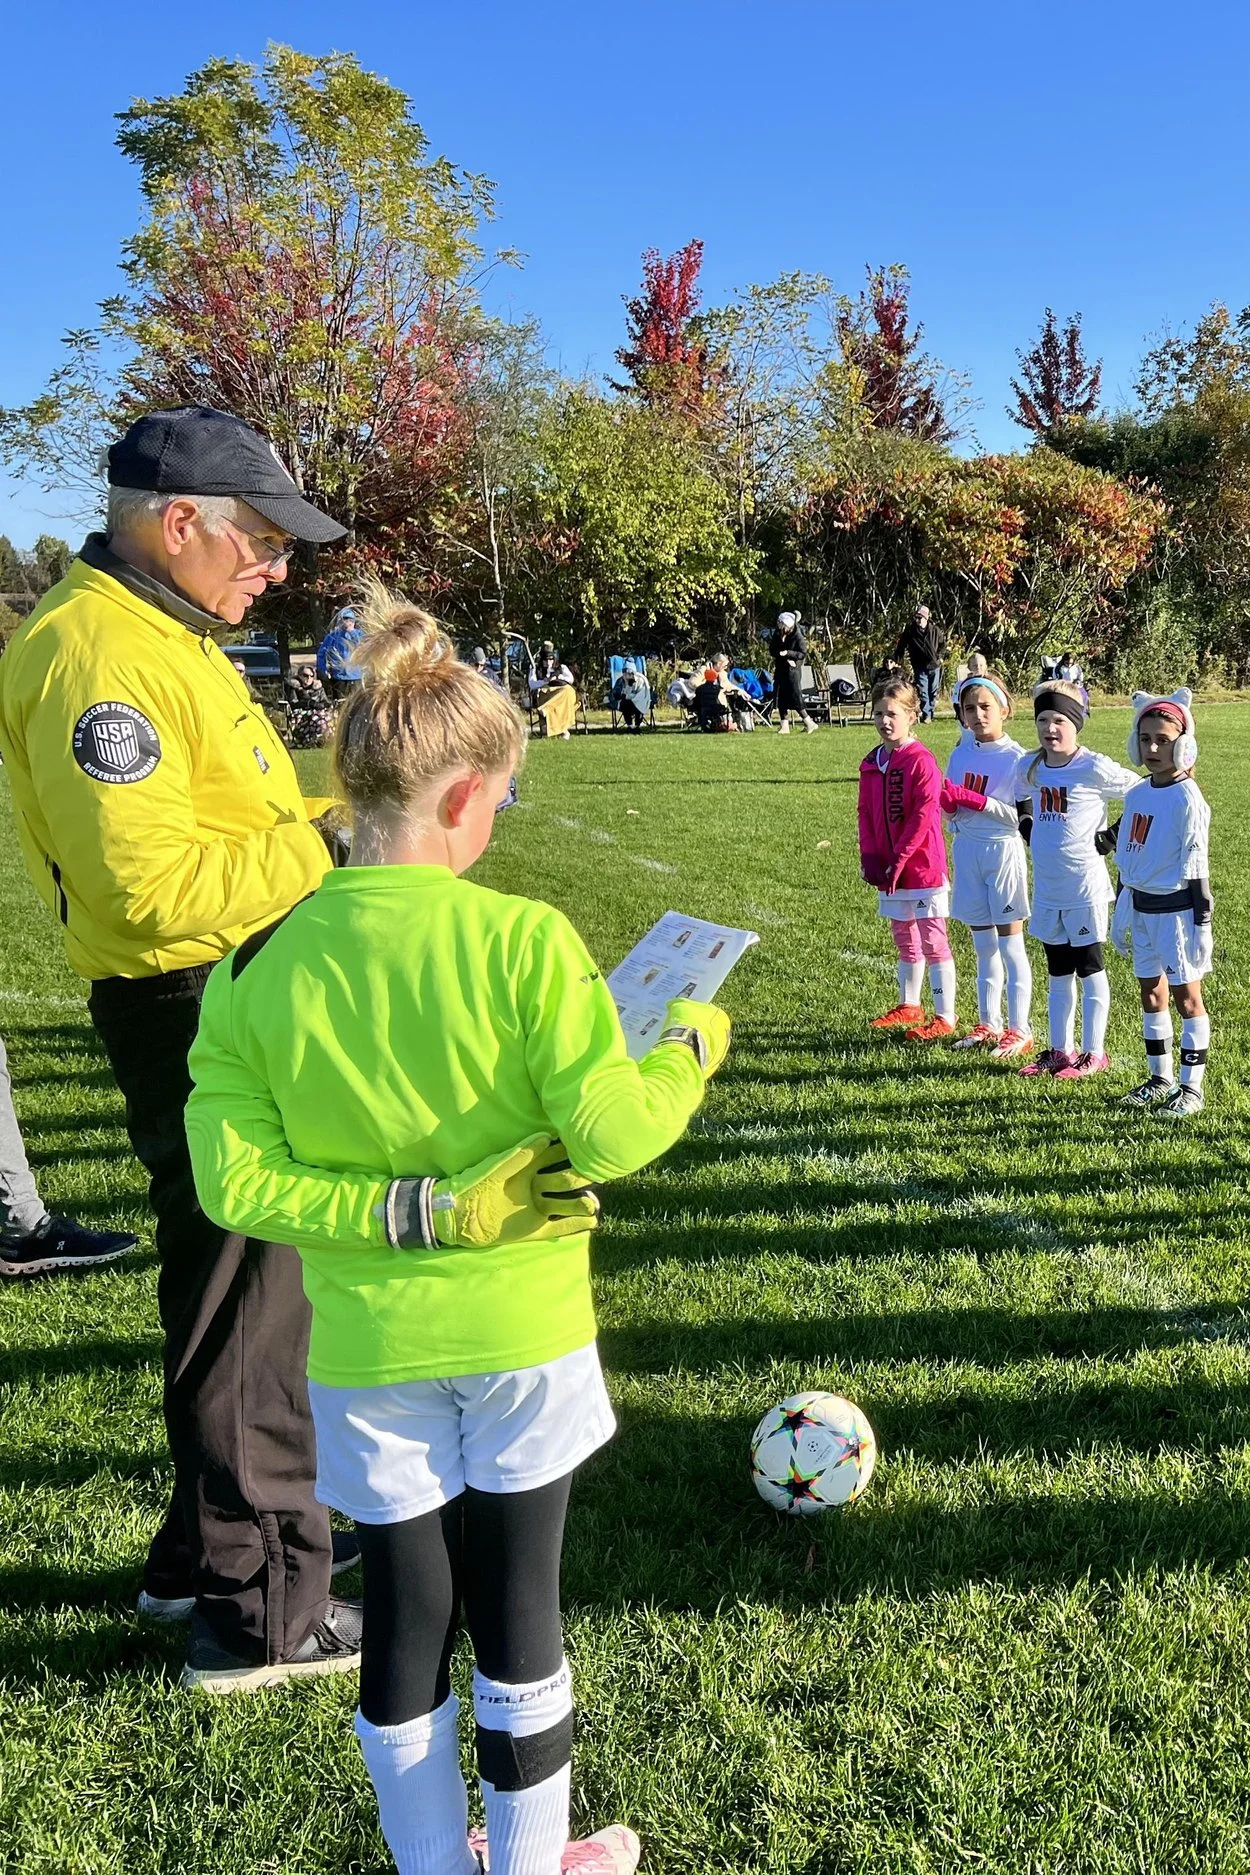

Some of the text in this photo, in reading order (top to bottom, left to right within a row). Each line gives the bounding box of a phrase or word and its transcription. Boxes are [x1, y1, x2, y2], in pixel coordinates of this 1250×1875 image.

[78, 703, 109, 729] SOCCER
[110, 702, 157, 741] FEDERATION
[95, 722, 133, 743] USA
[83, 755, 158, 782] REFEREE PROGRAM
[889, 768, 904, 824] SOCCER
